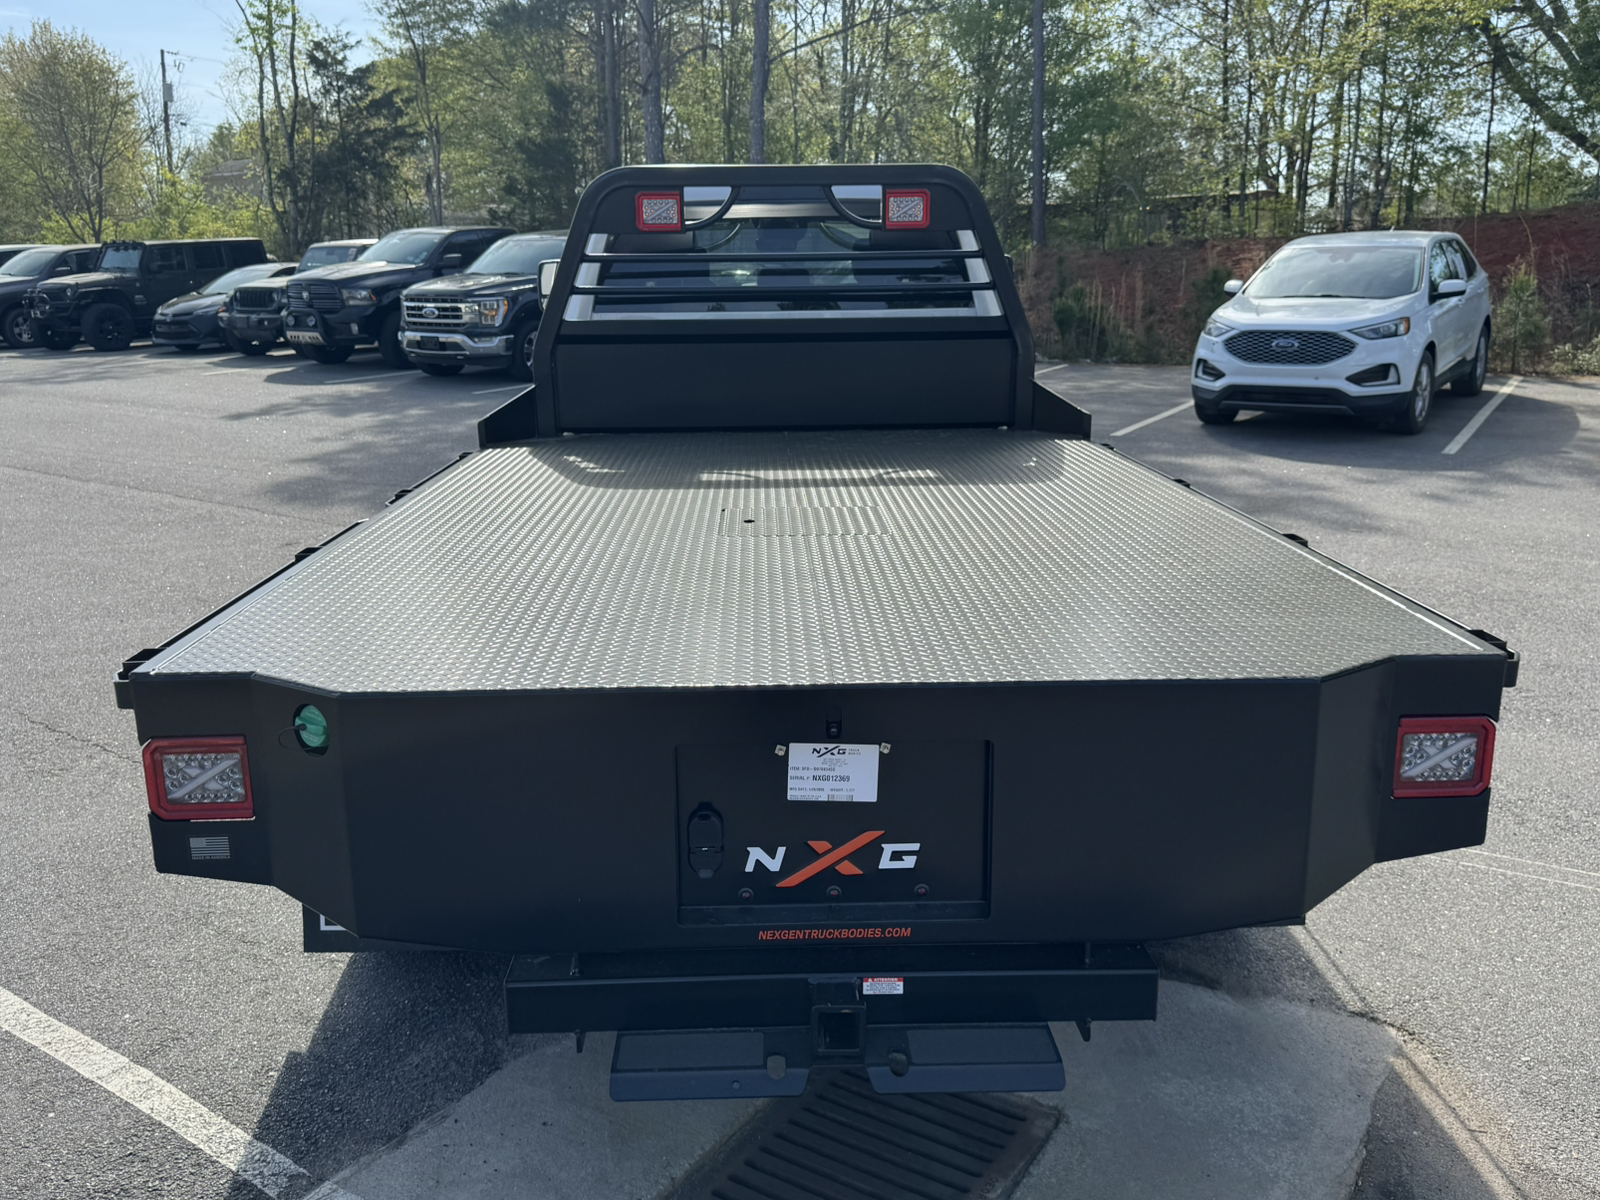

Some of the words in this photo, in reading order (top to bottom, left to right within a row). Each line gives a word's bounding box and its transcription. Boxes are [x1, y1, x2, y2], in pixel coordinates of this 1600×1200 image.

[811, 745, 847, 758] NXG
[812, 774, 851, 782] NXG012369
[744, 830, 921, 888] NXG
[758, 927, 912, 941] NEXGENTRUCKBODIES.COM
